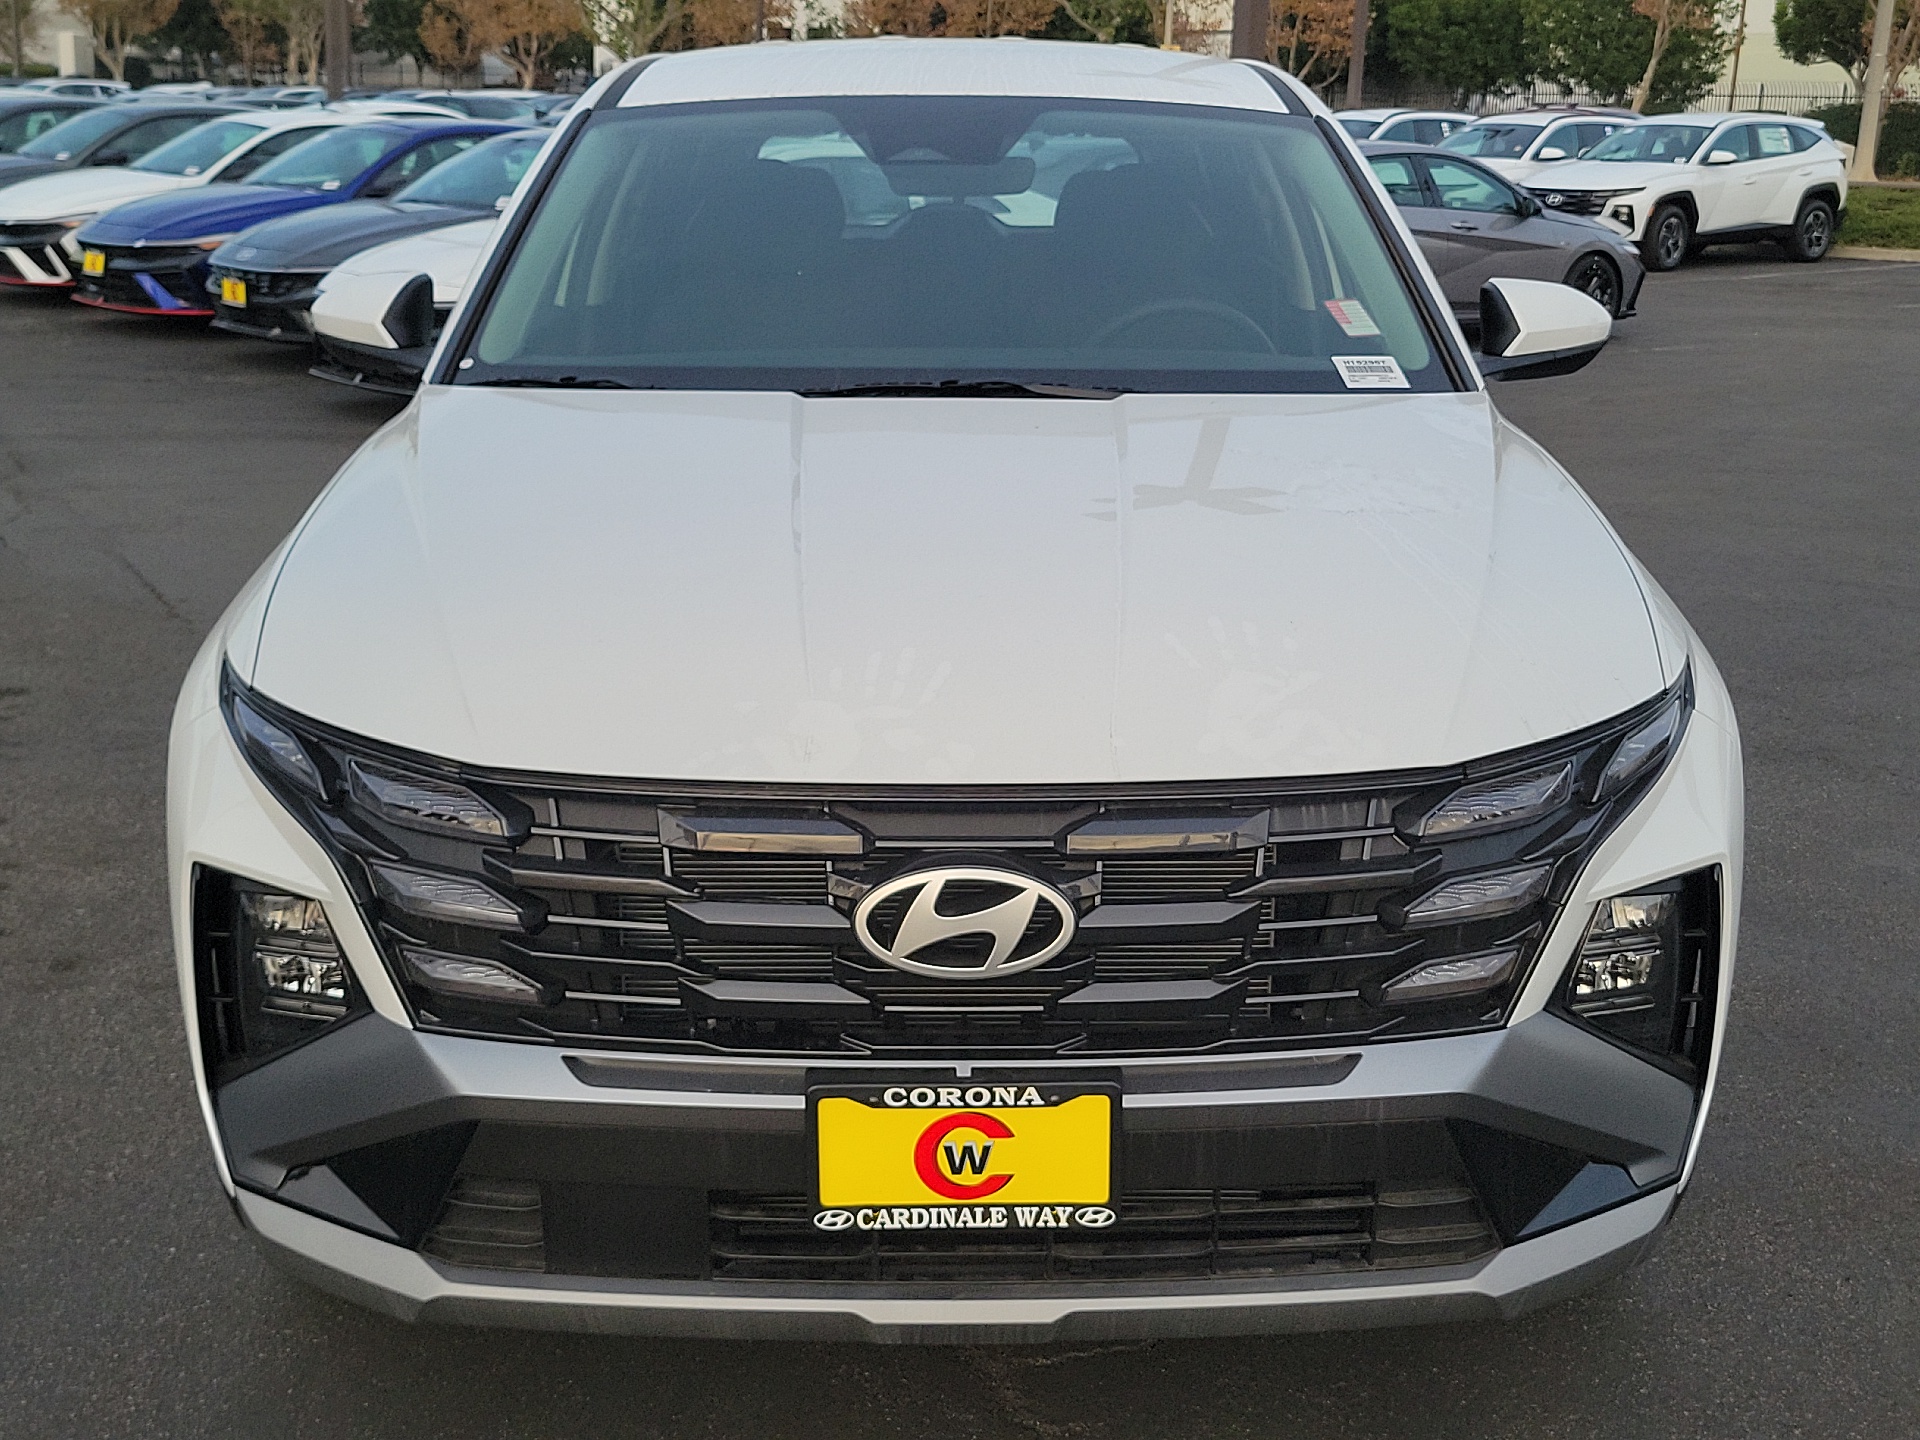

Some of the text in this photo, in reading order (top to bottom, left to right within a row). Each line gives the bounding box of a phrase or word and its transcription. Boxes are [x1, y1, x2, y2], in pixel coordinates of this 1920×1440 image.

[883, 1086, 1045, 1107] CORONA
[856, 1206, 1074, 1229] CARDINALE WAY
